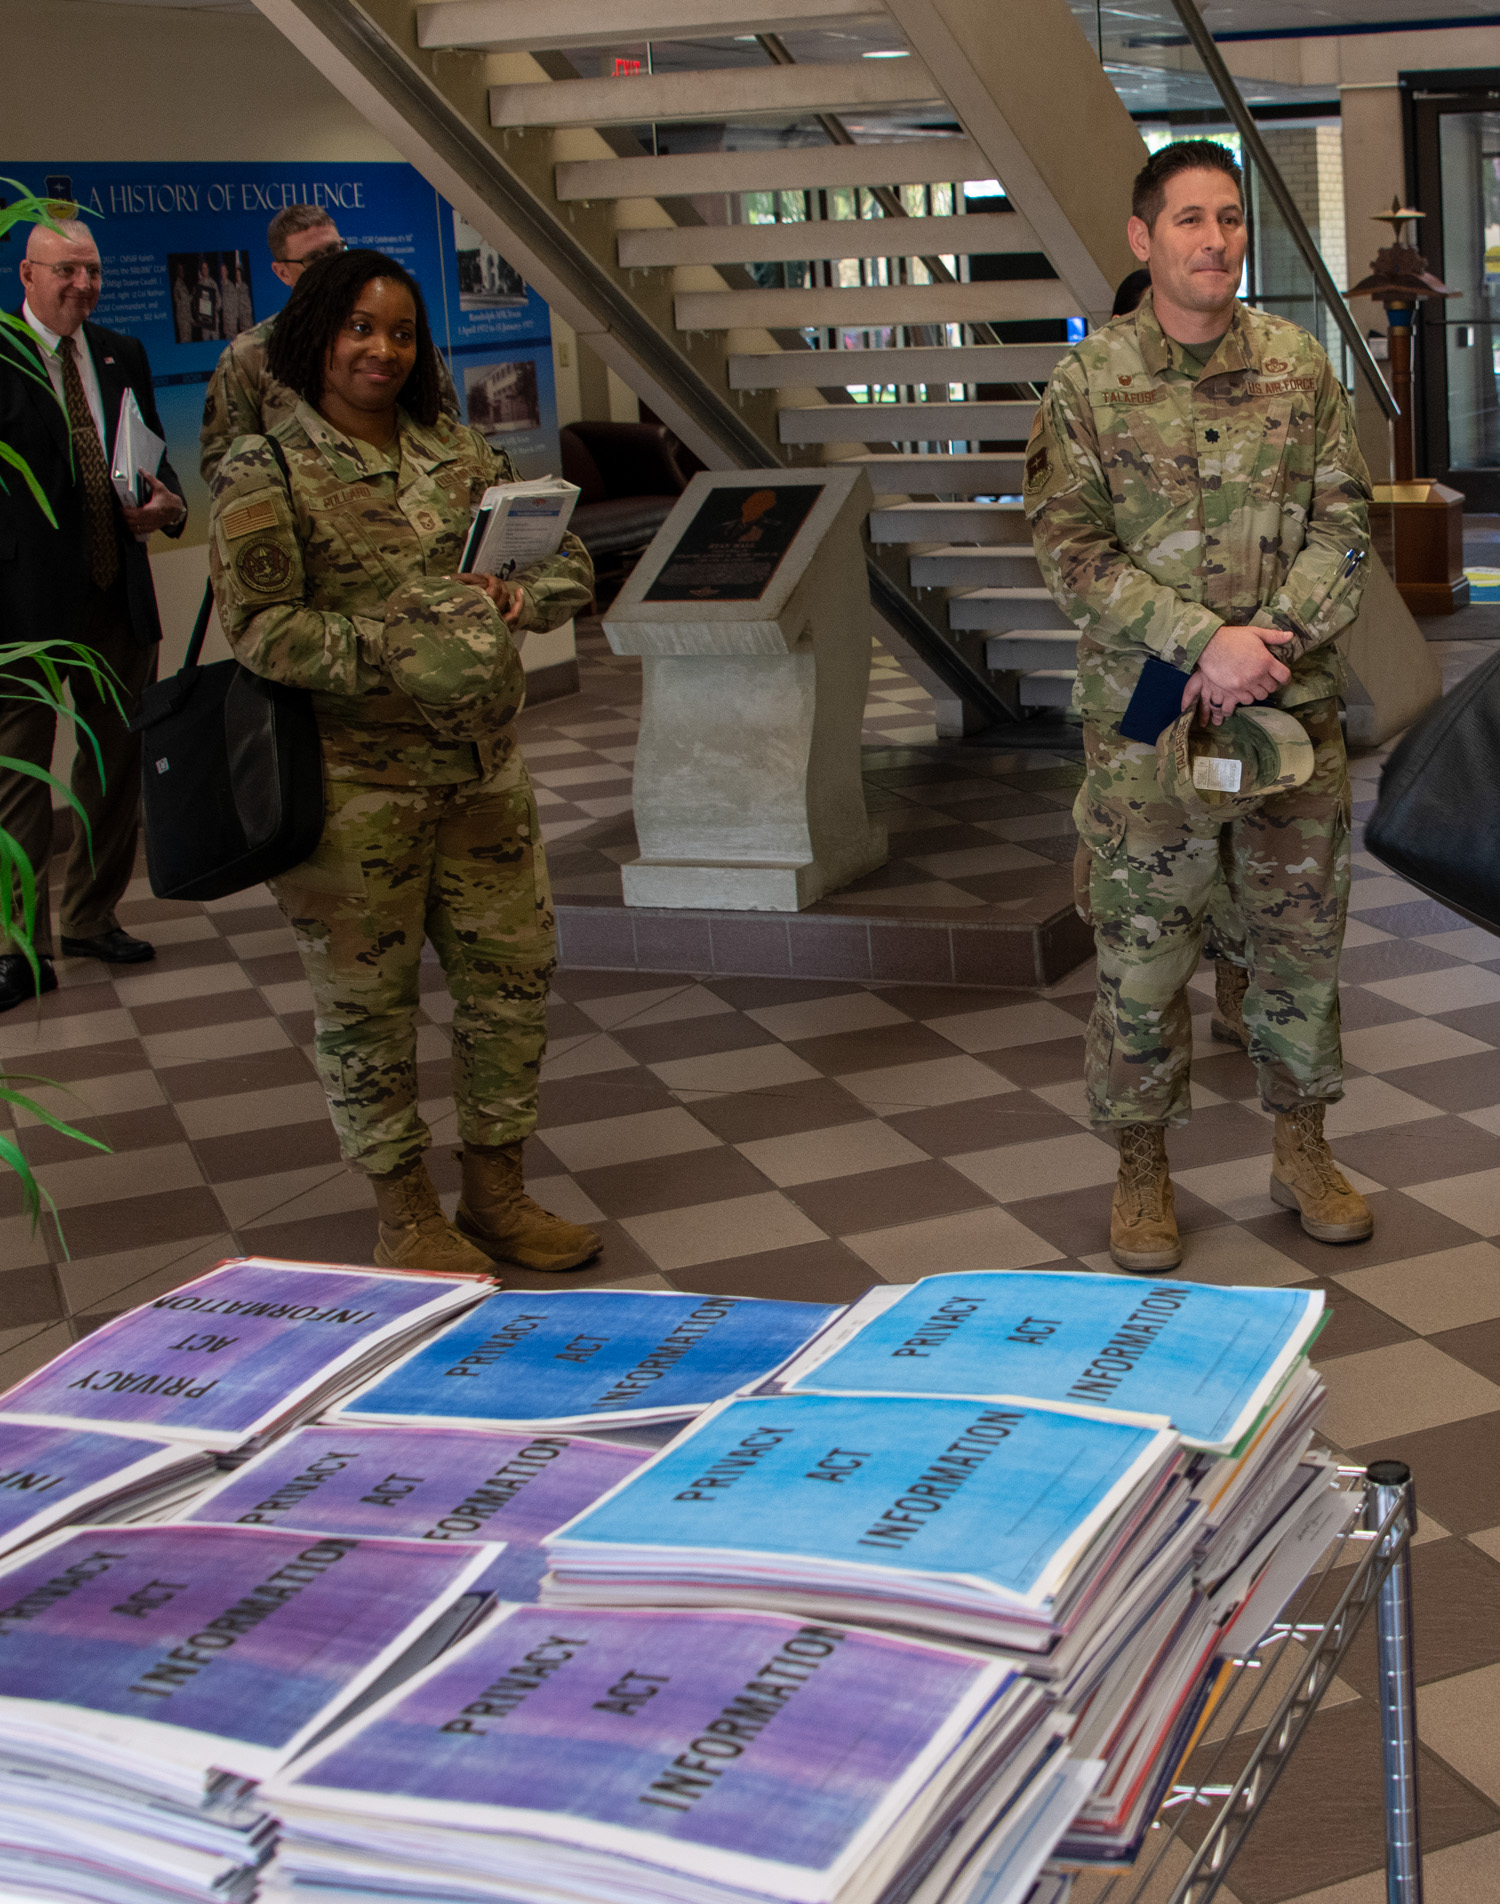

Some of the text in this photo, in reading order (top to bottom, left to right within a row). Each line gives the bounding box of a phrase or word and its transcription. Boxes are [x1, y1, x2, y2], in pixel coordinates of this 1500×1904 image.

[89, 181, 365, 214] A HISTORY OF EXCELLENCE
[1101, 389, 1157, 404] TALAFUSE
[1248, 378, 1315, 394] US AIR FORCE
[1175, 718, 1190, 775] TALAFUSE
[153, 1295, 377, 1326] INFORMATION
[892, 1295, 987, 1358] PRIVACY
[1006, 1315, 1063, 1346] ACT
[168, 1331, 241, 1353] ACT
[445, 1312, 549, 1378] PRIVACY
[554, 1333, 612, 1364] ACT
[591, 1297, 738, 1408] INFORMATION
[1066, 1286, 1192, 1403] INFORMATION
[70, 1368, 220, 1399] PRIVACY
[235, 1450, 361, 1524] PRIVACY
[359, 1472, 427, 1508] ACT
[422, 1436, 573, 1541] FORMATION
[672, 1425, 796, 1503] PRIVACY
[804, 1447, 873, 1485] ACT
[857, 1409, 1027, 1551] INFORMATION
[109, 1577, 190, 1620] ACT
[127, 1538, 360, 1701] INFORMATION
[439, 1633, 588, 1738] PRIVACY
[592, 1667, 672, 1718] ACT
[638, 1624, 848, 1814] INFORMATION
